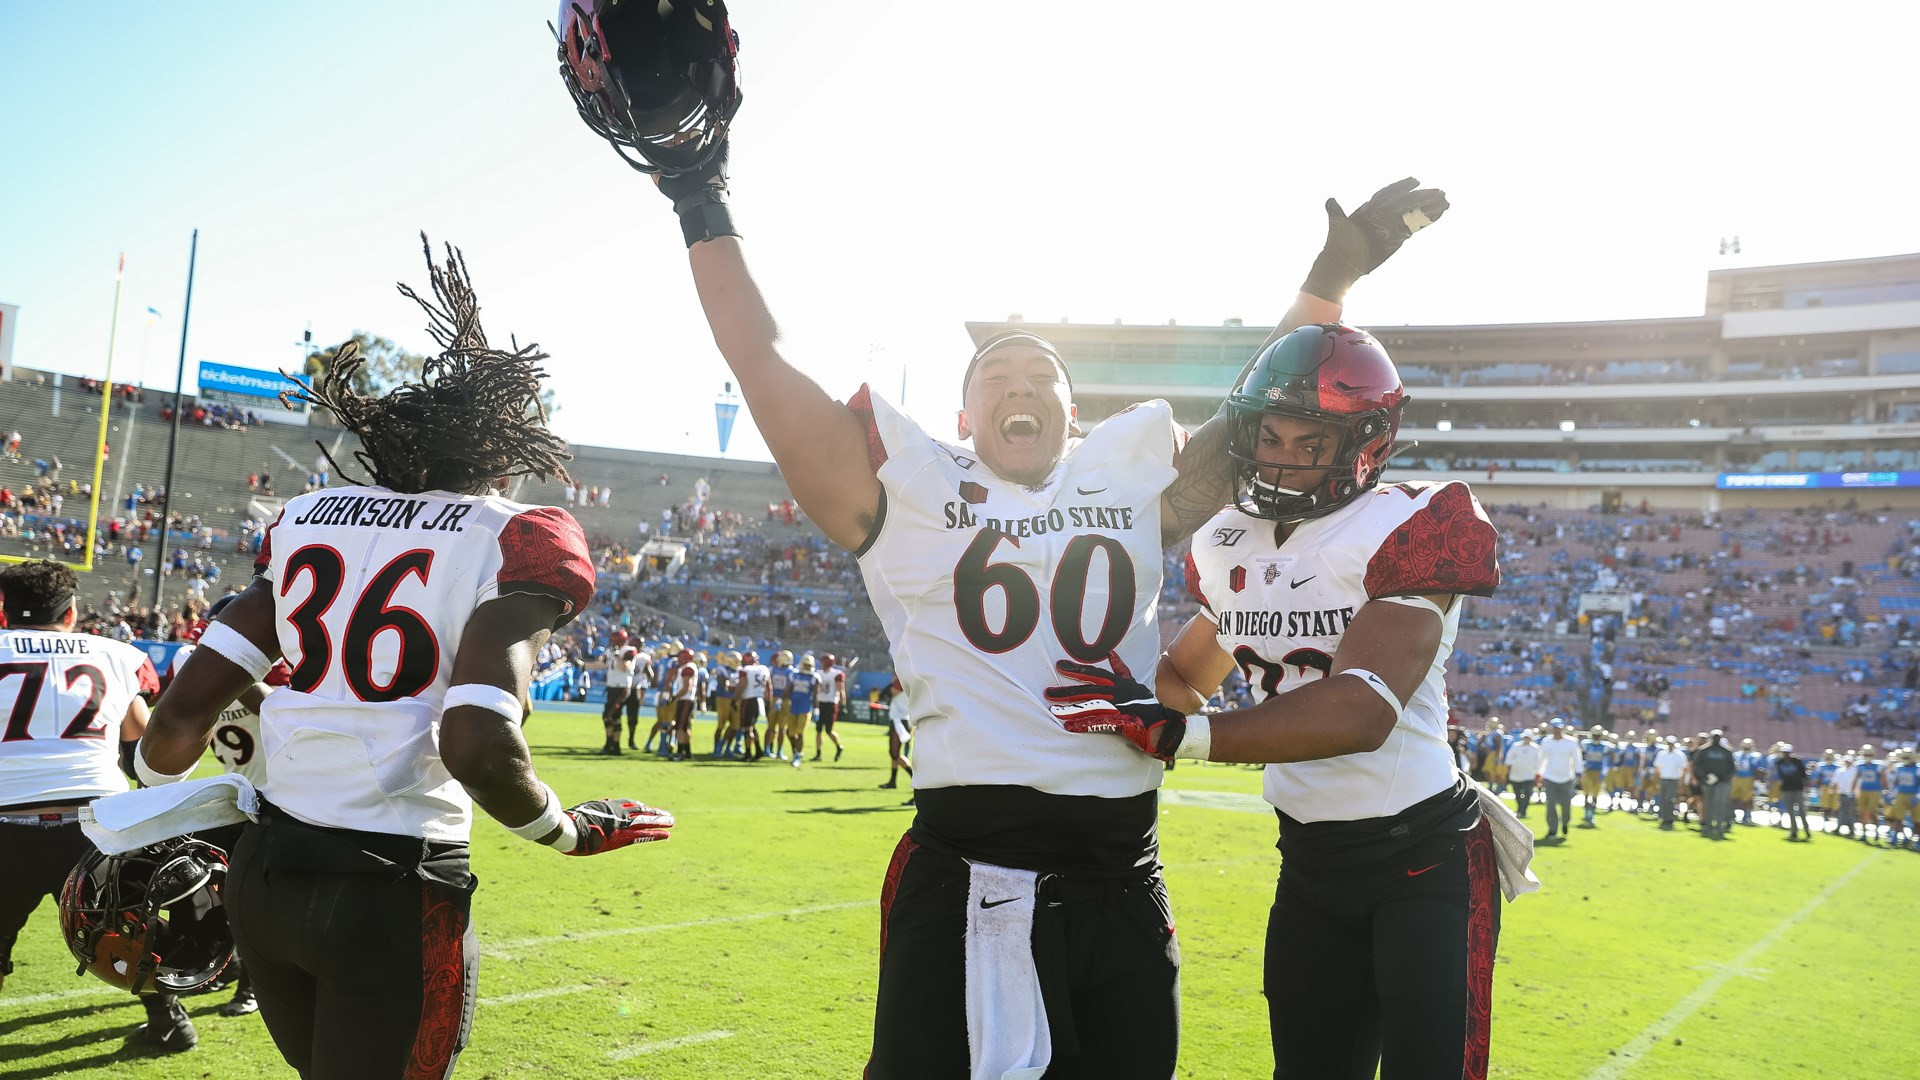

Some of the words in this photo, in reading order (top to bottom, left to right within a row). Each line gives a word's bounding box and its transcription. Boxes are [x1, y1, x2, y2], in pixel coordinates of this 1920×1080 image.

[200, 368, 300, 392] ticketmaster
[295, 496, 428, 530] JOHNSON
[421, 503, 472, 532] JR.
[986, 508, 1065, 538] DIEGO
[1068, 506, 1133, 530] STATE
[953, 527, 1136, 664] 60
[280, 543, 440, 702] 36
[1217, 611, 1232, 636] AN
[1235, 611, 1283, 637] DIEGO
[1287, 607, 1353, 637] STATE
[14, 637, 90, 654] ULUAVE
[0, 662, 108, 743] 72
[221, 708, 251, 721] STATE
[210, 724, 255, 766] 9
